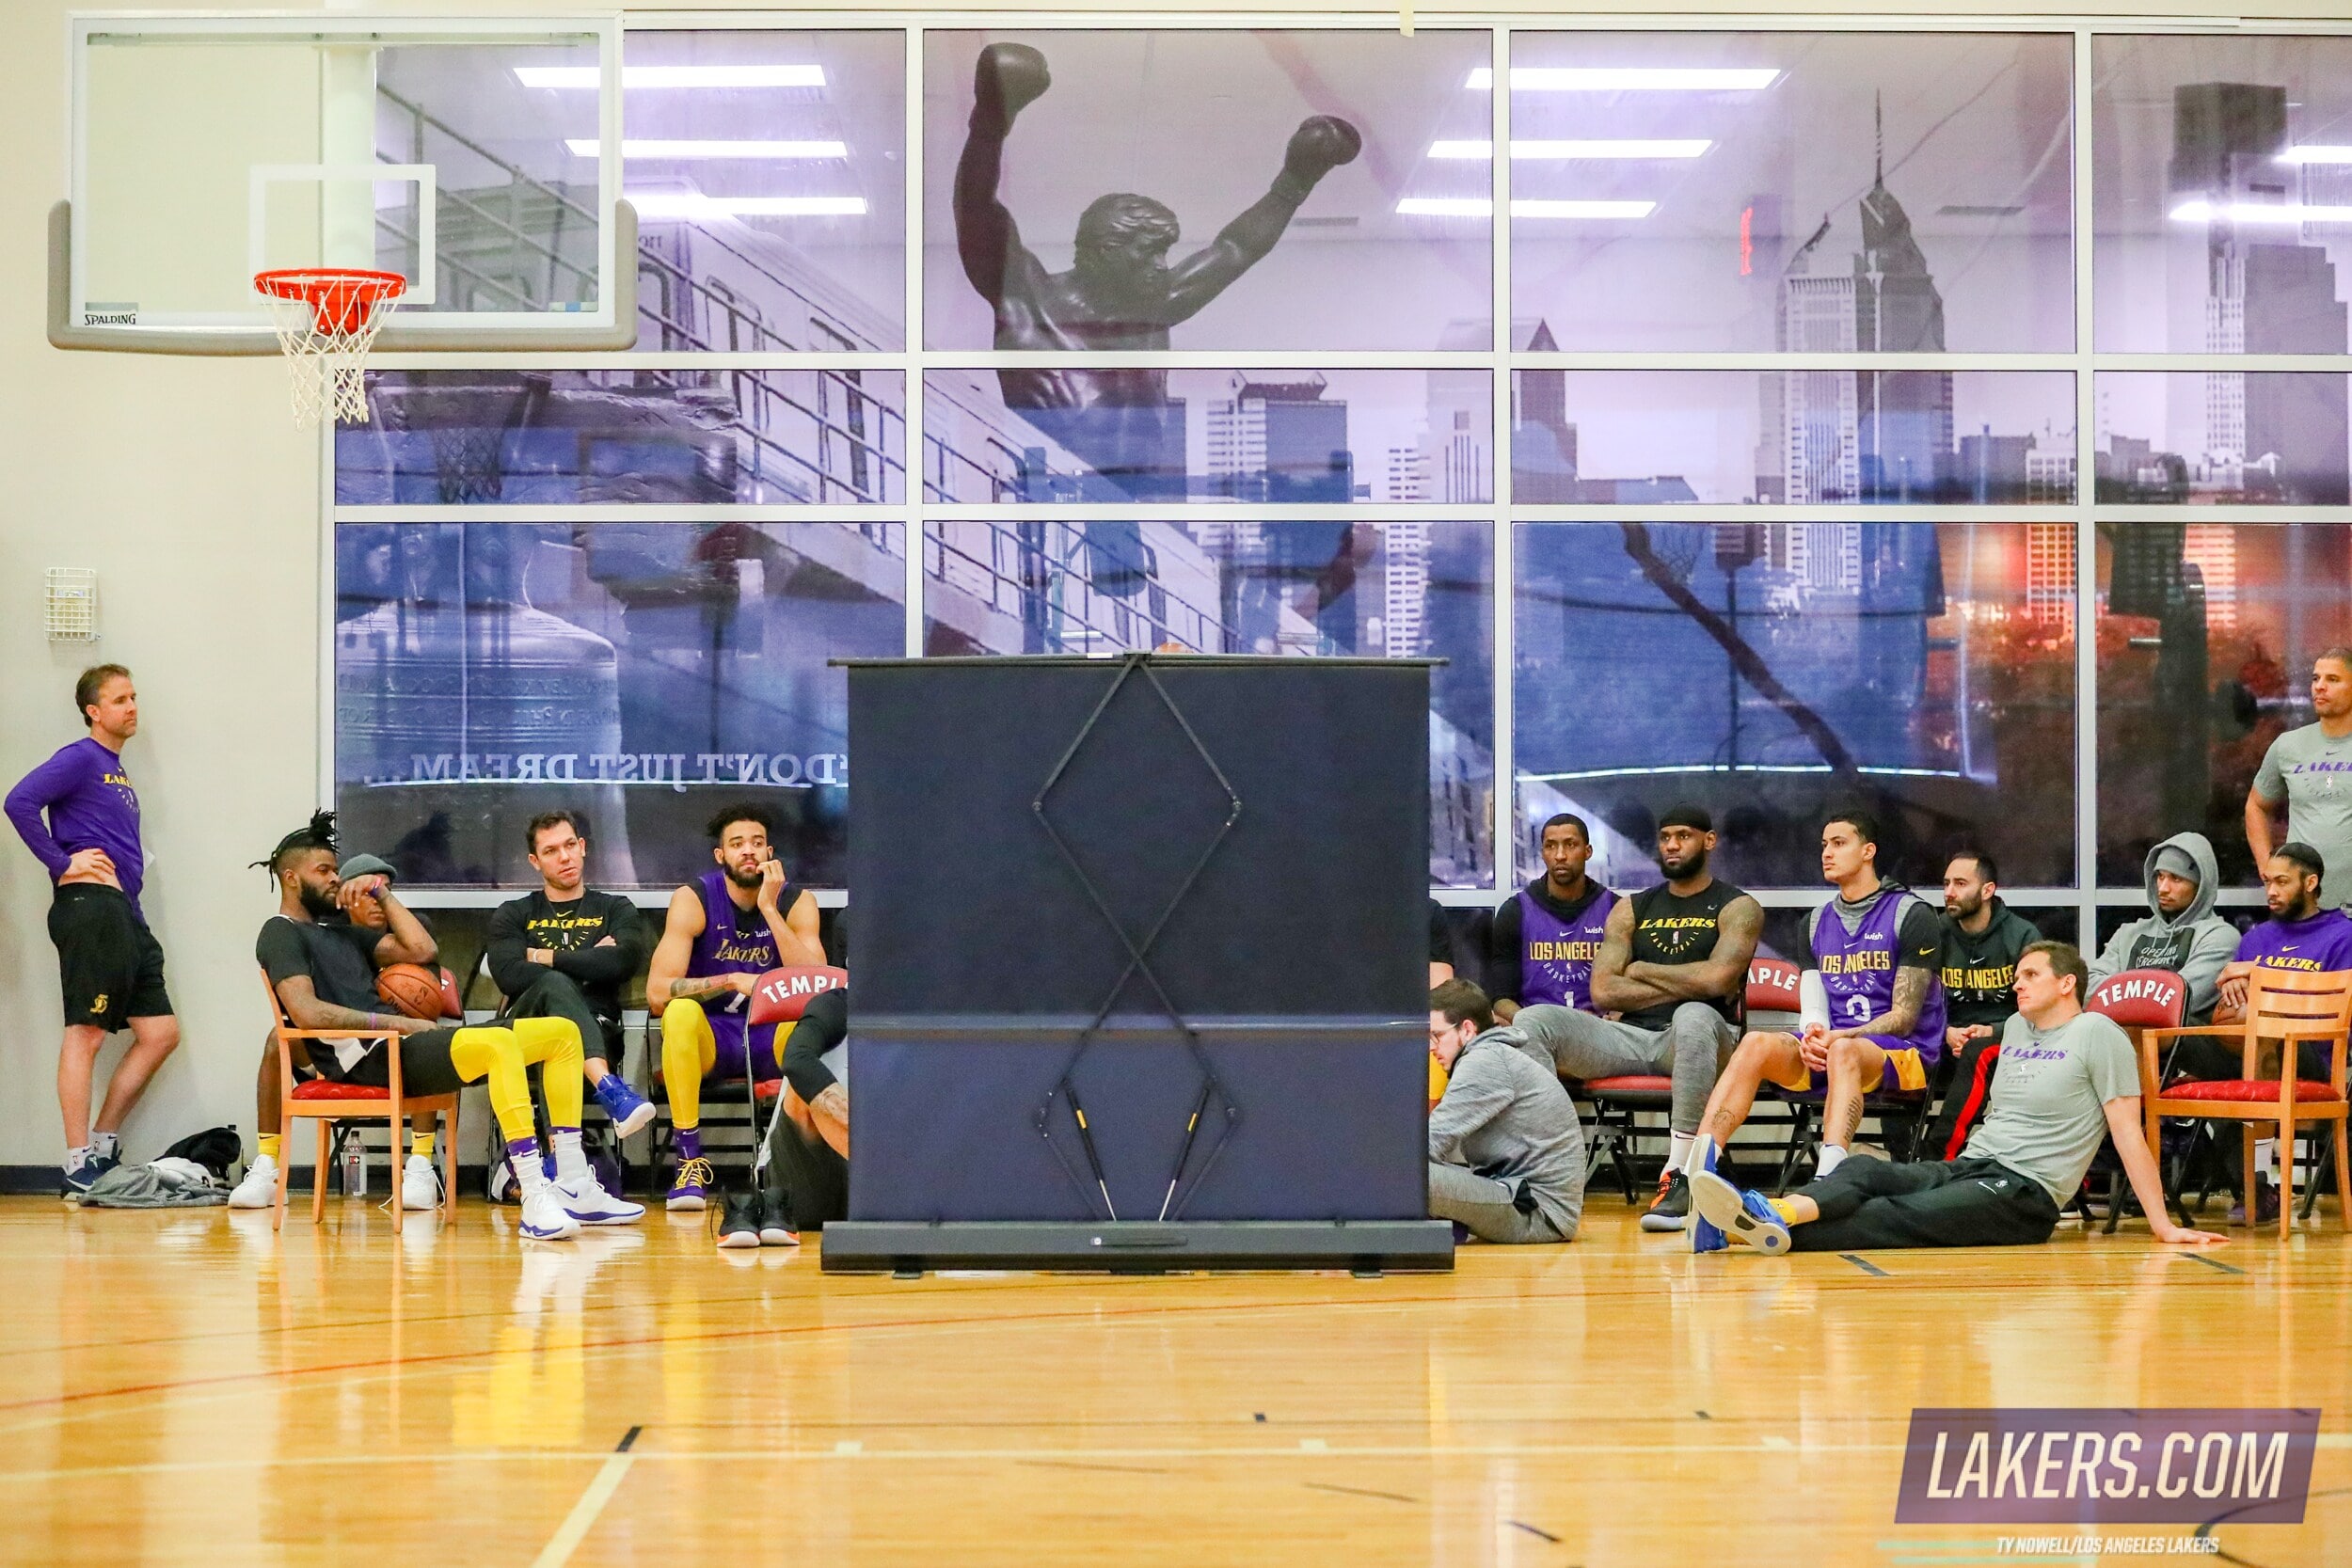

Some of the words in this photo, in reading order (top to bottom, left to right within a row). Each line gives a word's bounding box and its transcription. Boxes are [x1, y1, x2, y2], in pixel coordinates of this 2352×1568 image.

[85, 313, 136, 325] SPALDING
[2293, 761, 2352, 774] LAKE
[103, 773, 133, 788] LAK
[1583, 926, 1604, 934] wish
[1638, 917, 1717, 930] LAKERS
[1864, 932, 1883, 941] wish
[712, 938, 774, 967] LAKERS
[1529, 941, 1553, 960] LOS
[1555, 941, 1604, 960] ANGELE
[1942, 966, 1963, 989] LOS
[1564, 990, 1575, 1009] 1
[2097, 979, 2176, 1007] TEMPLE
